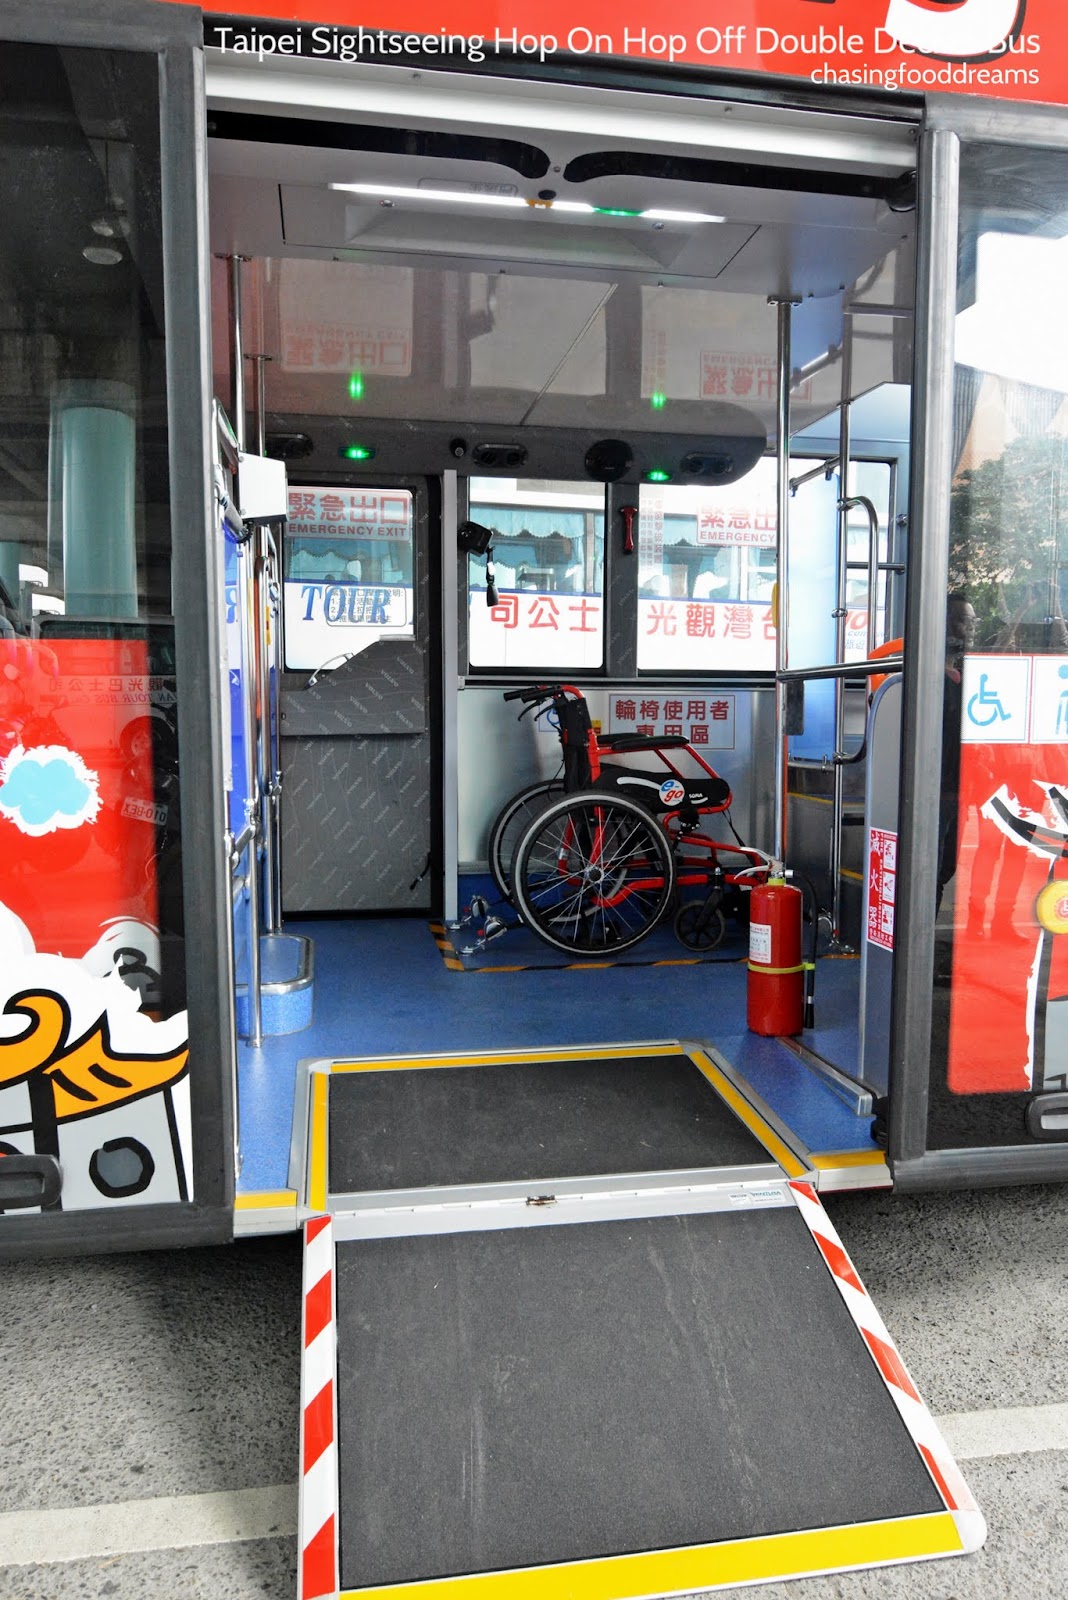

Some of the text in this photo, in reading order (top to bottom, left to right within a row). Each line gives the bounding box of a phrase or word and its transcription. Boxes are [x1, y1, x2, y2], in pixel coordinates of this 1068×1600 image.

[288, 492, 408, 525] 緊急出口
[288, 523, 407, 537] EMERGENCY EXIT
[700, 530, 776, 543] EMERGENCY
[301, 585, 392, 625] TOUR
[615, 700, 729, 721] 輪椅使用者
[663, 789, 684, 803] go
